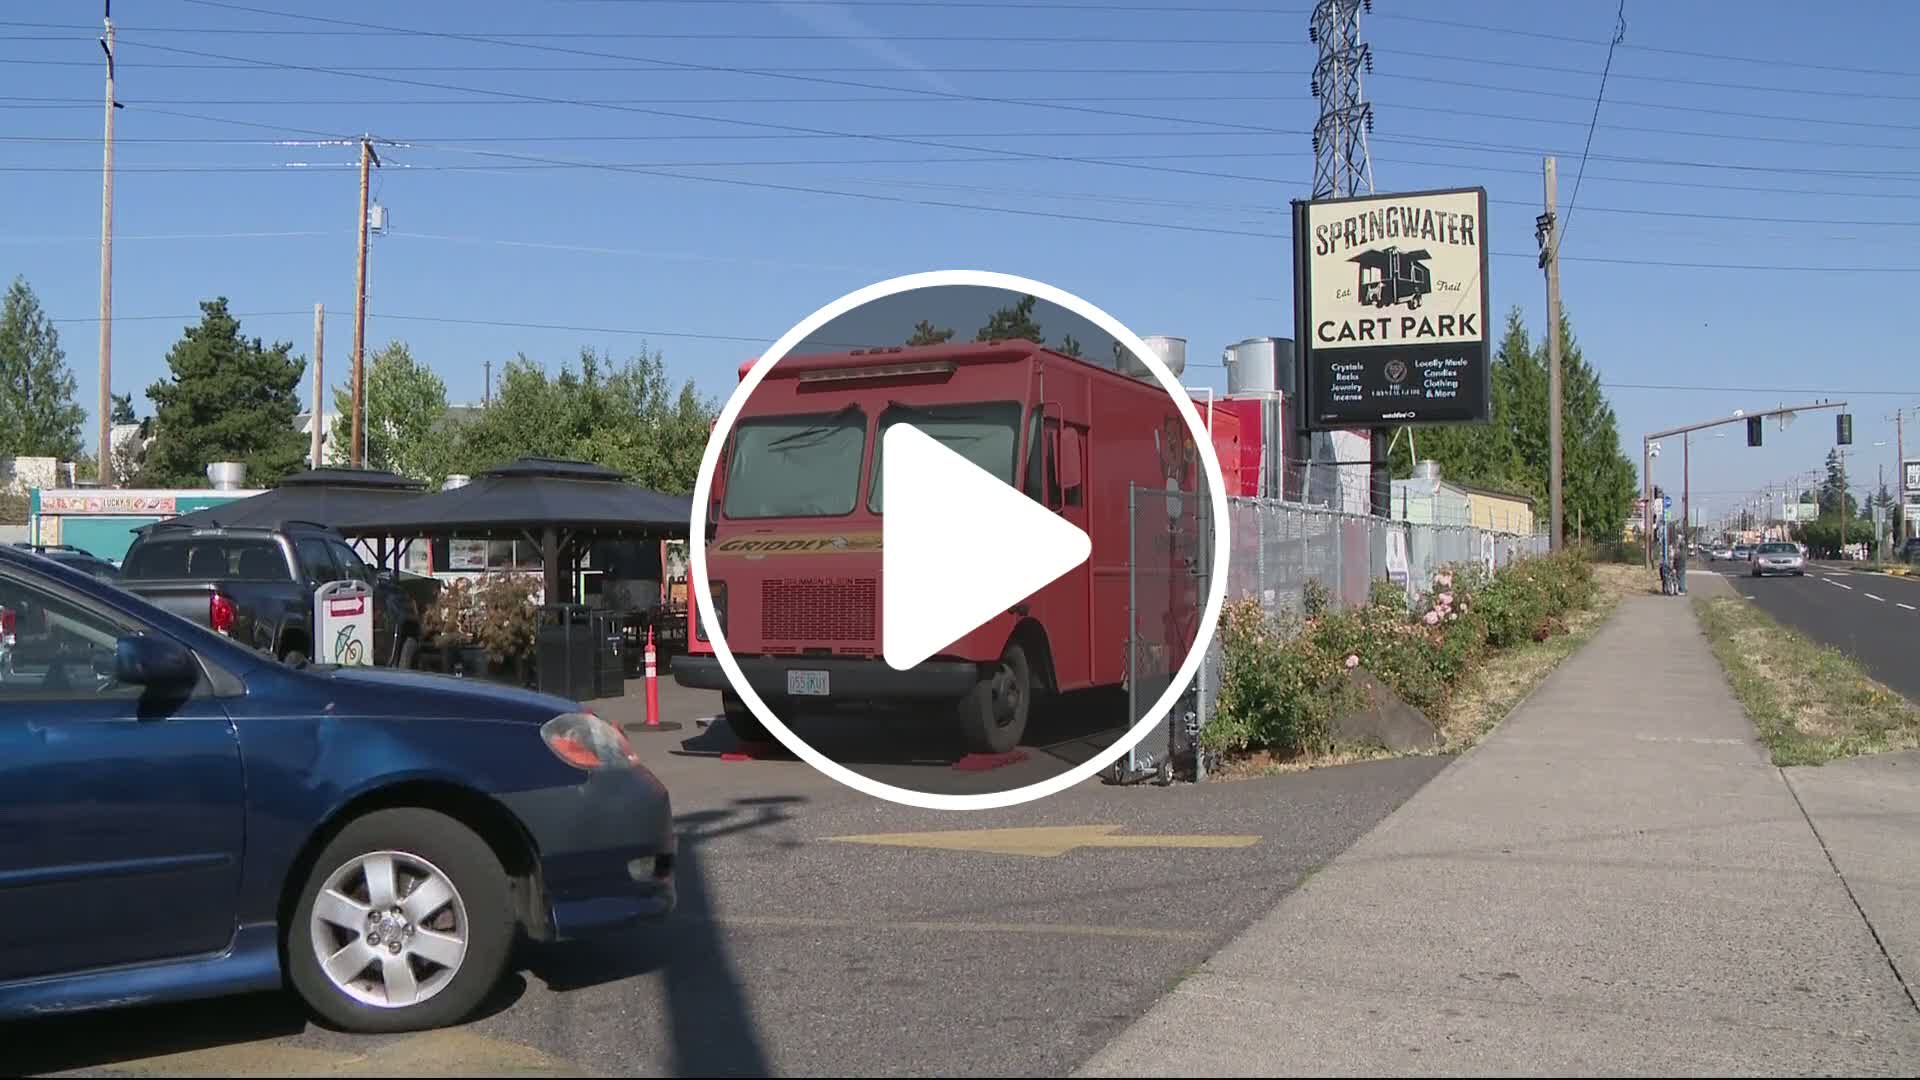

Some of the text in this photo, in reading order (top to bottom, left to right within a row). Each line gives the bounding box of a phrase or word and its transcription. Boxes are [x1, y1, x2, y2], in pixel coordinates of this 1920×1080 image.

[1315, 206, 1475, 256] SPRINGWATER
[1436, 280, 1461, 292] Trail
[1336, 288, 1352, 299] Eat
[1317, 313, 1478, 342] CART PARK
[1331, 361, 1364, 372] Crystals
[1414, 357, 1468, 369] Locally Made
[1336, 373, 1359, 381] Rocks
[1423, 369, 1457, 377] Candles
[1330, 384, 1362, 393] Jewelry
[1423, 379, 1458, 389] Clothing
[1333, 393, 1363, 401] Incense
[1425, 389, 1456, 398] & More
